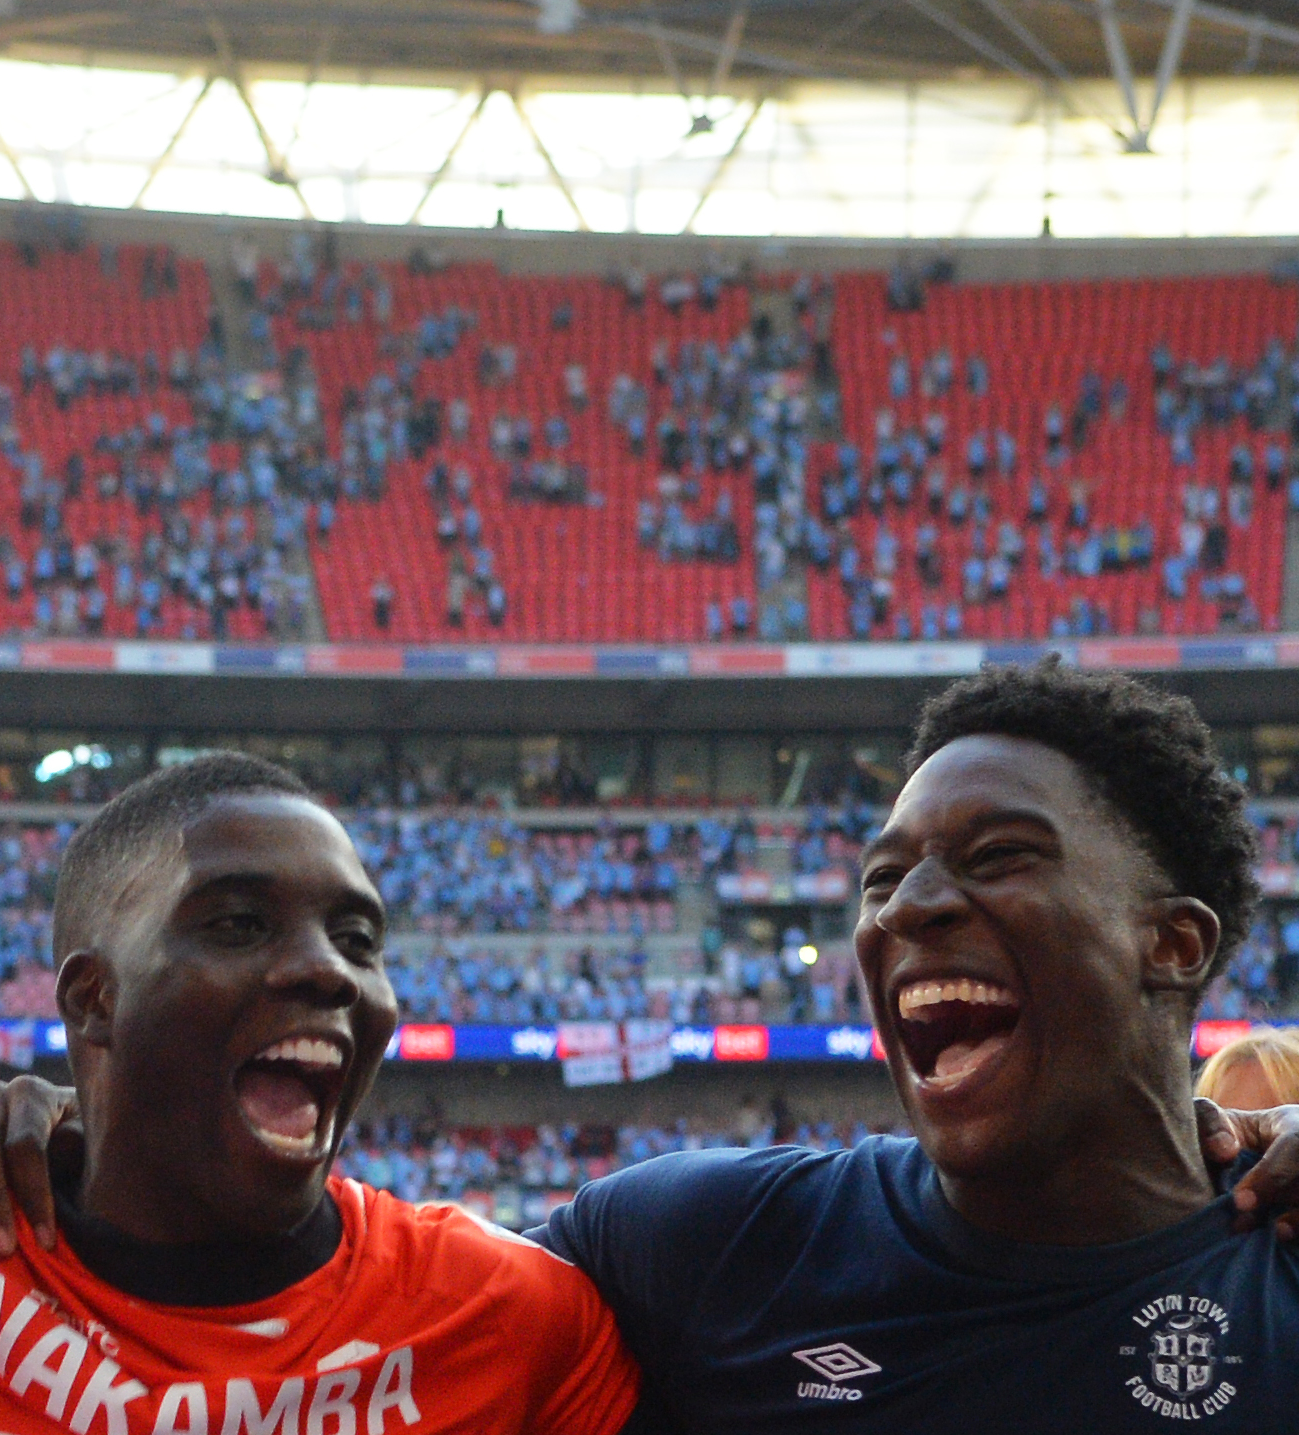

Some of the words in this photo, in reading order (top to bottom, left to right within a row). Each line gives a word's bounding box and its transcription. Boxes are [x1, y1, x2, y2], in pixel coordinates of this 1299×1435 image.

[797, 1382, 863, 1400] umbro
[1125, 1375, 1201, 1420] FOOTBALL
[1202, 1381, 1237, 1416] CLUB
